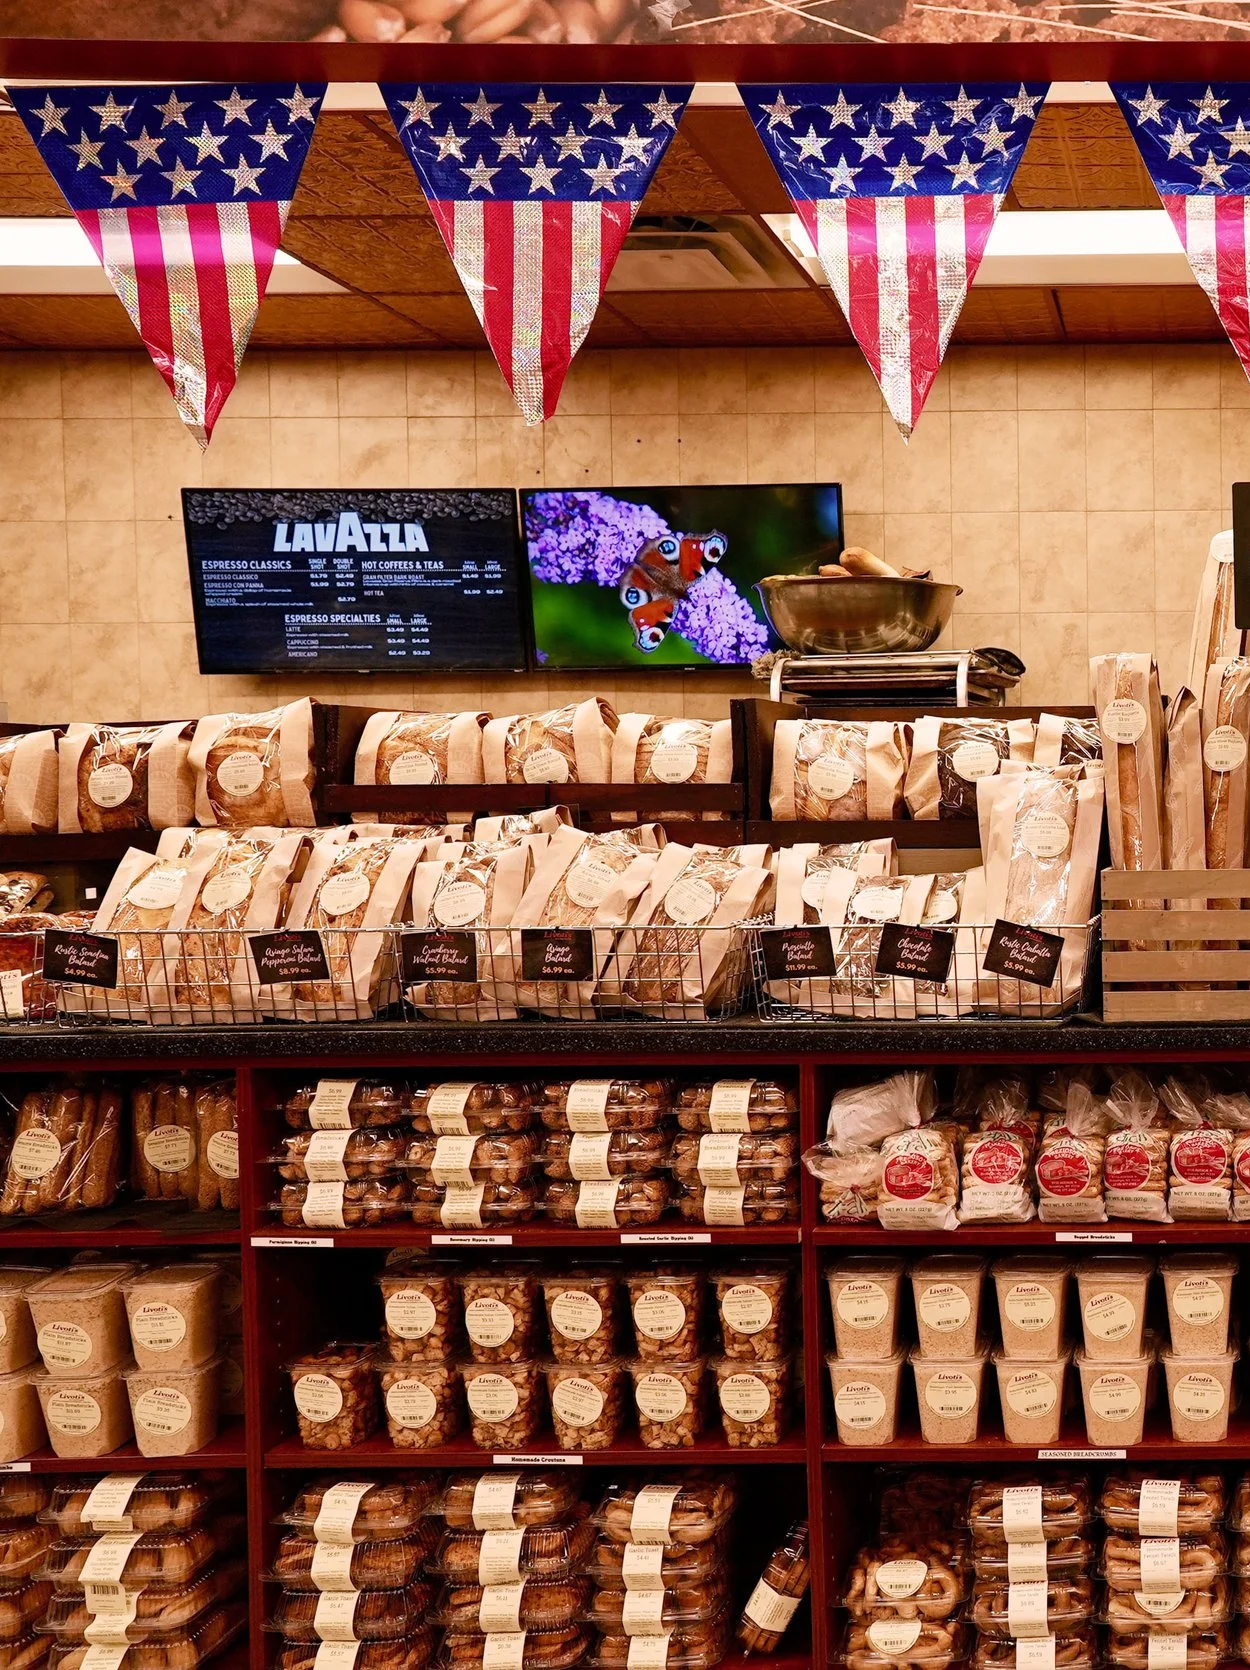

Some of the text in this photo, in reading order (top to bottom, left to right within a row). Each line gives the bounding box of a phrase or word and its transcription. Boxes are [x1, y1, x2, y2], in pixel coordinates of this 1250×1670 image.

[273, 512, 429, 552] LAVAZZA
[202, 560, 292, 570] ESPRESSO CLASSICS
[361, 561, 444, 570] HOT COFFEES & TEAS
[284, 614, 381, 623] ESPRESSO SPECIALTIES
[265, 943, 314, 958] Asiago Salami
[422, 943, 459, 955] Cranberry
[546, 943, 570, 955] Asiago
[782, 941, 815, 951] Prosciutto
[897, 937, 932, 952] Chocolate
[999, 936, 1051, 958] Rustic Ciabatta
[54, 944, 110, 961] Rustic Semolina
[544, 952, 572, 963] Batard
[787, 950, 813, 961] Batard
[900, 949, 929, 961] Batard
[1009, 948, 1037, 964] Batard
[68, 954, 97, 968] Batard
[261, 953, 322, 969] Pepperoni Batard
[412, 953, 469, 965] Walnut Batard
[64, 967, 86, 976] $4.99
[279, 967, 300, 975] $8.99
[425, 967, 446, 975] $5.99
[542, 966, 563, 974] $6.99
[785, 963, 806, 971] $11.99
[896, 961, 928, 973] $5.99 ea.
[1003, 960, 1035, 975] $5.99 ea.
